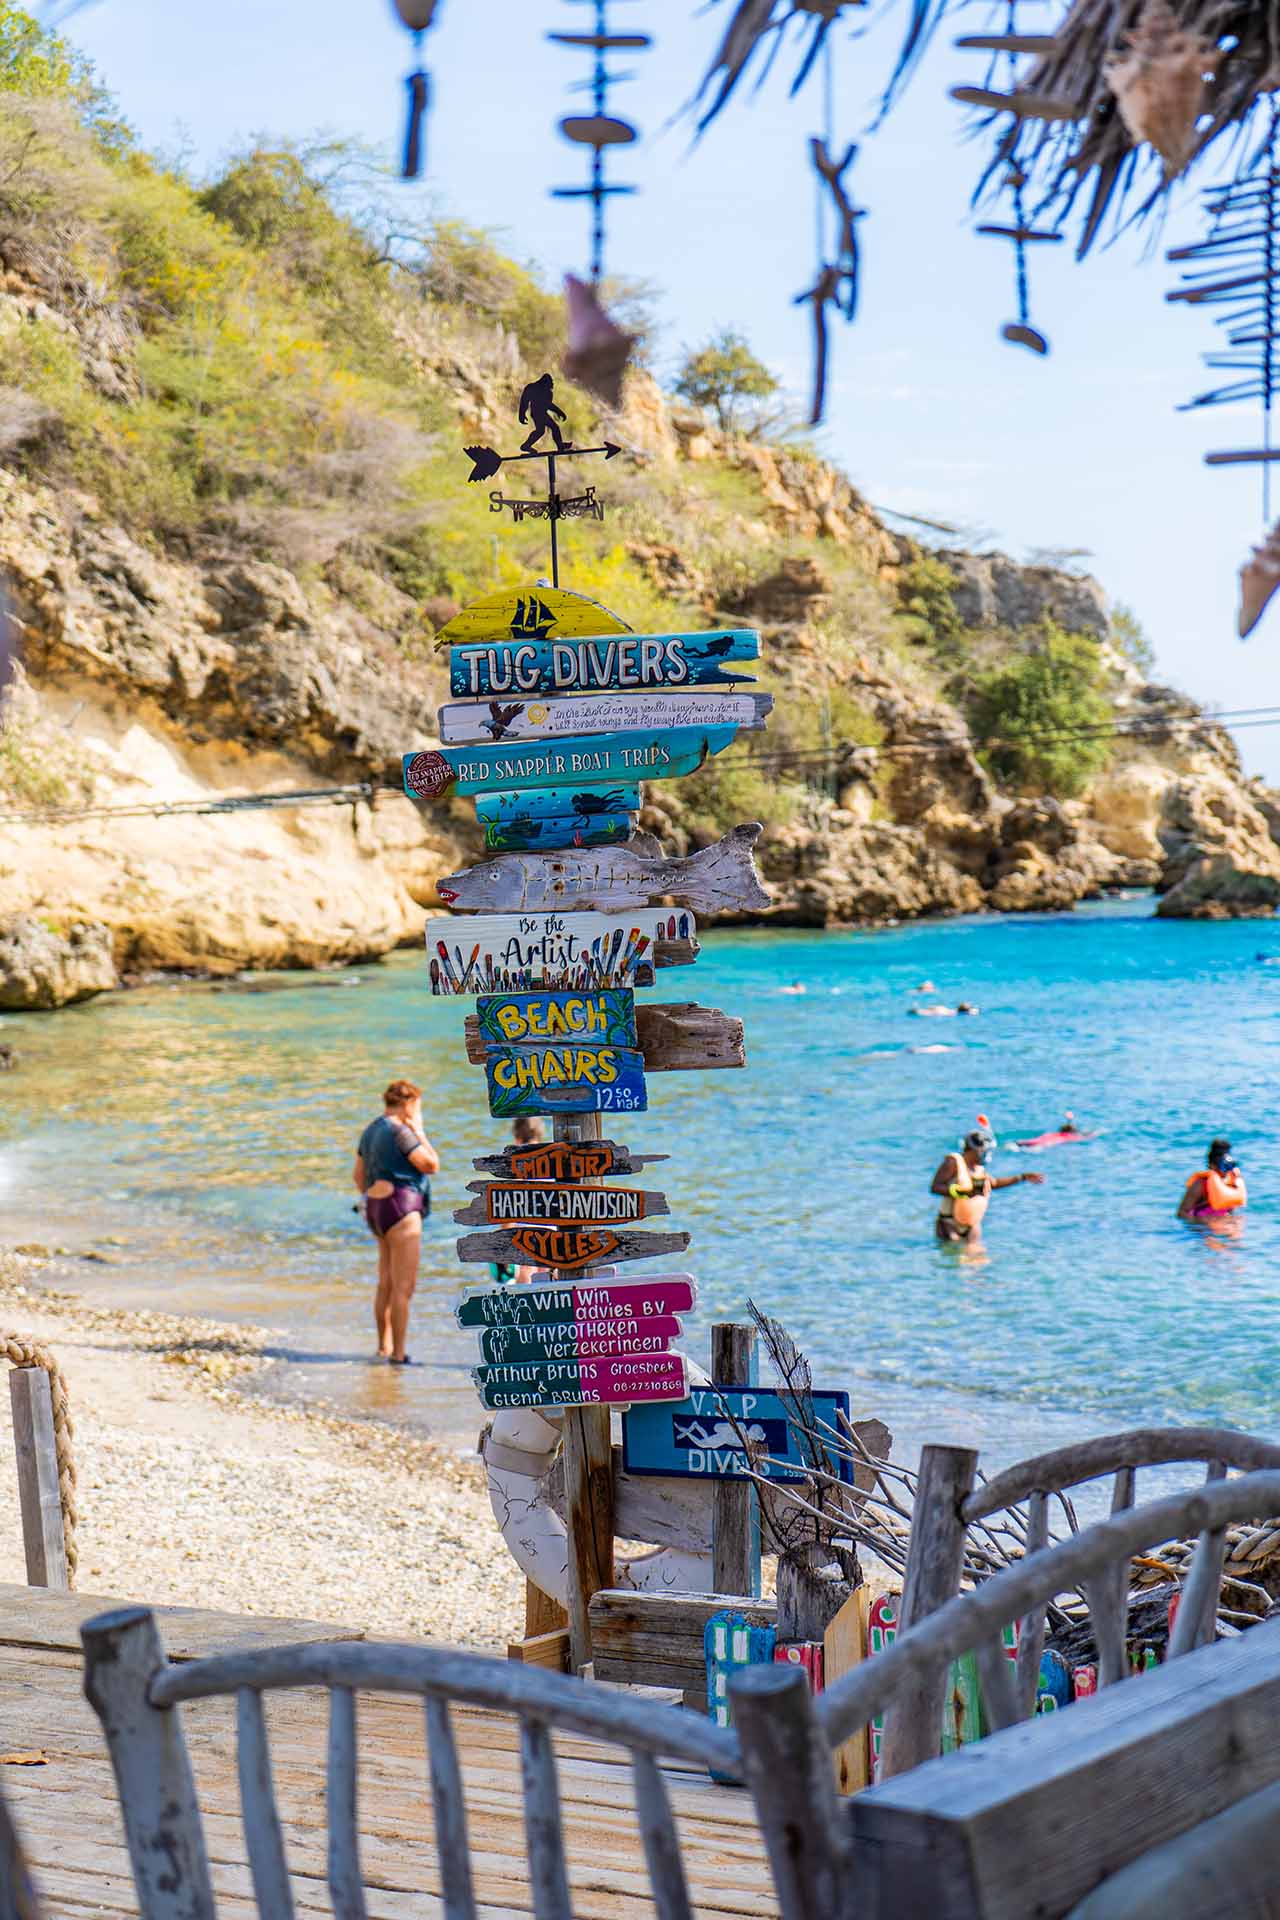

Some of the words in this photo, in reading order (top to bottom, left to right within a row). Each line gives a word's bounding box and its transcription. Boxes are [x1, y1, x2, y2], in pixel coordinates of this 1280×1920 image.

[489, 491, 503, 512] S
[461, 645, 541, 693] TUG
[552, 639, 687, 687] DIVERS
[458, 762, 490, 782] RED
[495, 755, 567, 780] SNAPPER
[572, 751, 611, 772] BOAT
[621, 745, 671, 767] TRIPS
[519, 917, 538, 933] Be
[544, 914, 565, 934] the
[500, 934, 583, 969] Artist
[496, 997, 608, 1040] BEACH
[494, 1049, 618, 1089] CHAIRS
[522, 1150, 600, 1179] MOTOR
[492, 1190, 638, 1219] HARLEY-DAVIDSON
[523, 1230, 600, 1260] CYCLES
[532, 1292, 572, 1311] Win
[577, 1288, 610, 1306] Win
[575, 1302, 633, 1320] advies
[486, 1365, 540, 1384] Arthur
[547, 1363, 598, 1381] Bruns
[538, 1380, 548, 1394] &
[688, 1448, 770, 1476] DIVES
